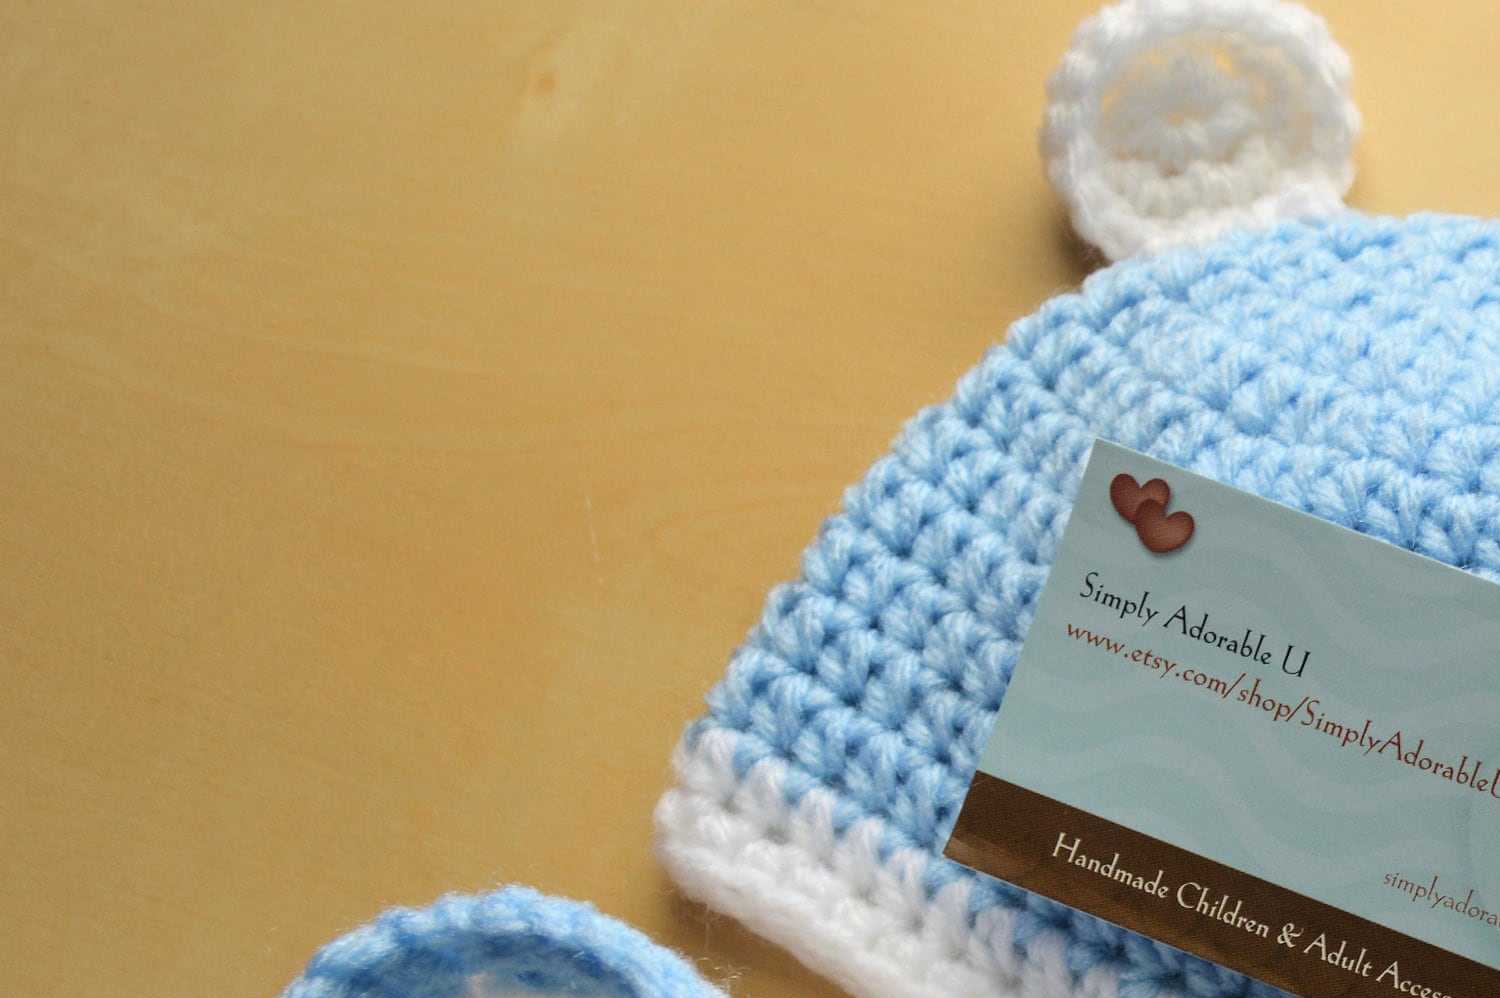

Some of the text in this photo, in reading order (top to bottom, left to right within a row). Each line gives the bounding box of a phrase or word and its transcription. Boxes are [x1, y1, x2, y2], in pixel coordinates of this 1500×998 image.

[1079, 571, 1311, 678] Simply Adorable U
[1051, 832, 1169, 899] Handmade
[1176, 881, 1270, 939] Children
[1276, 922, 1305, 948] &
[1303, 932, 1372, 978] Adult
